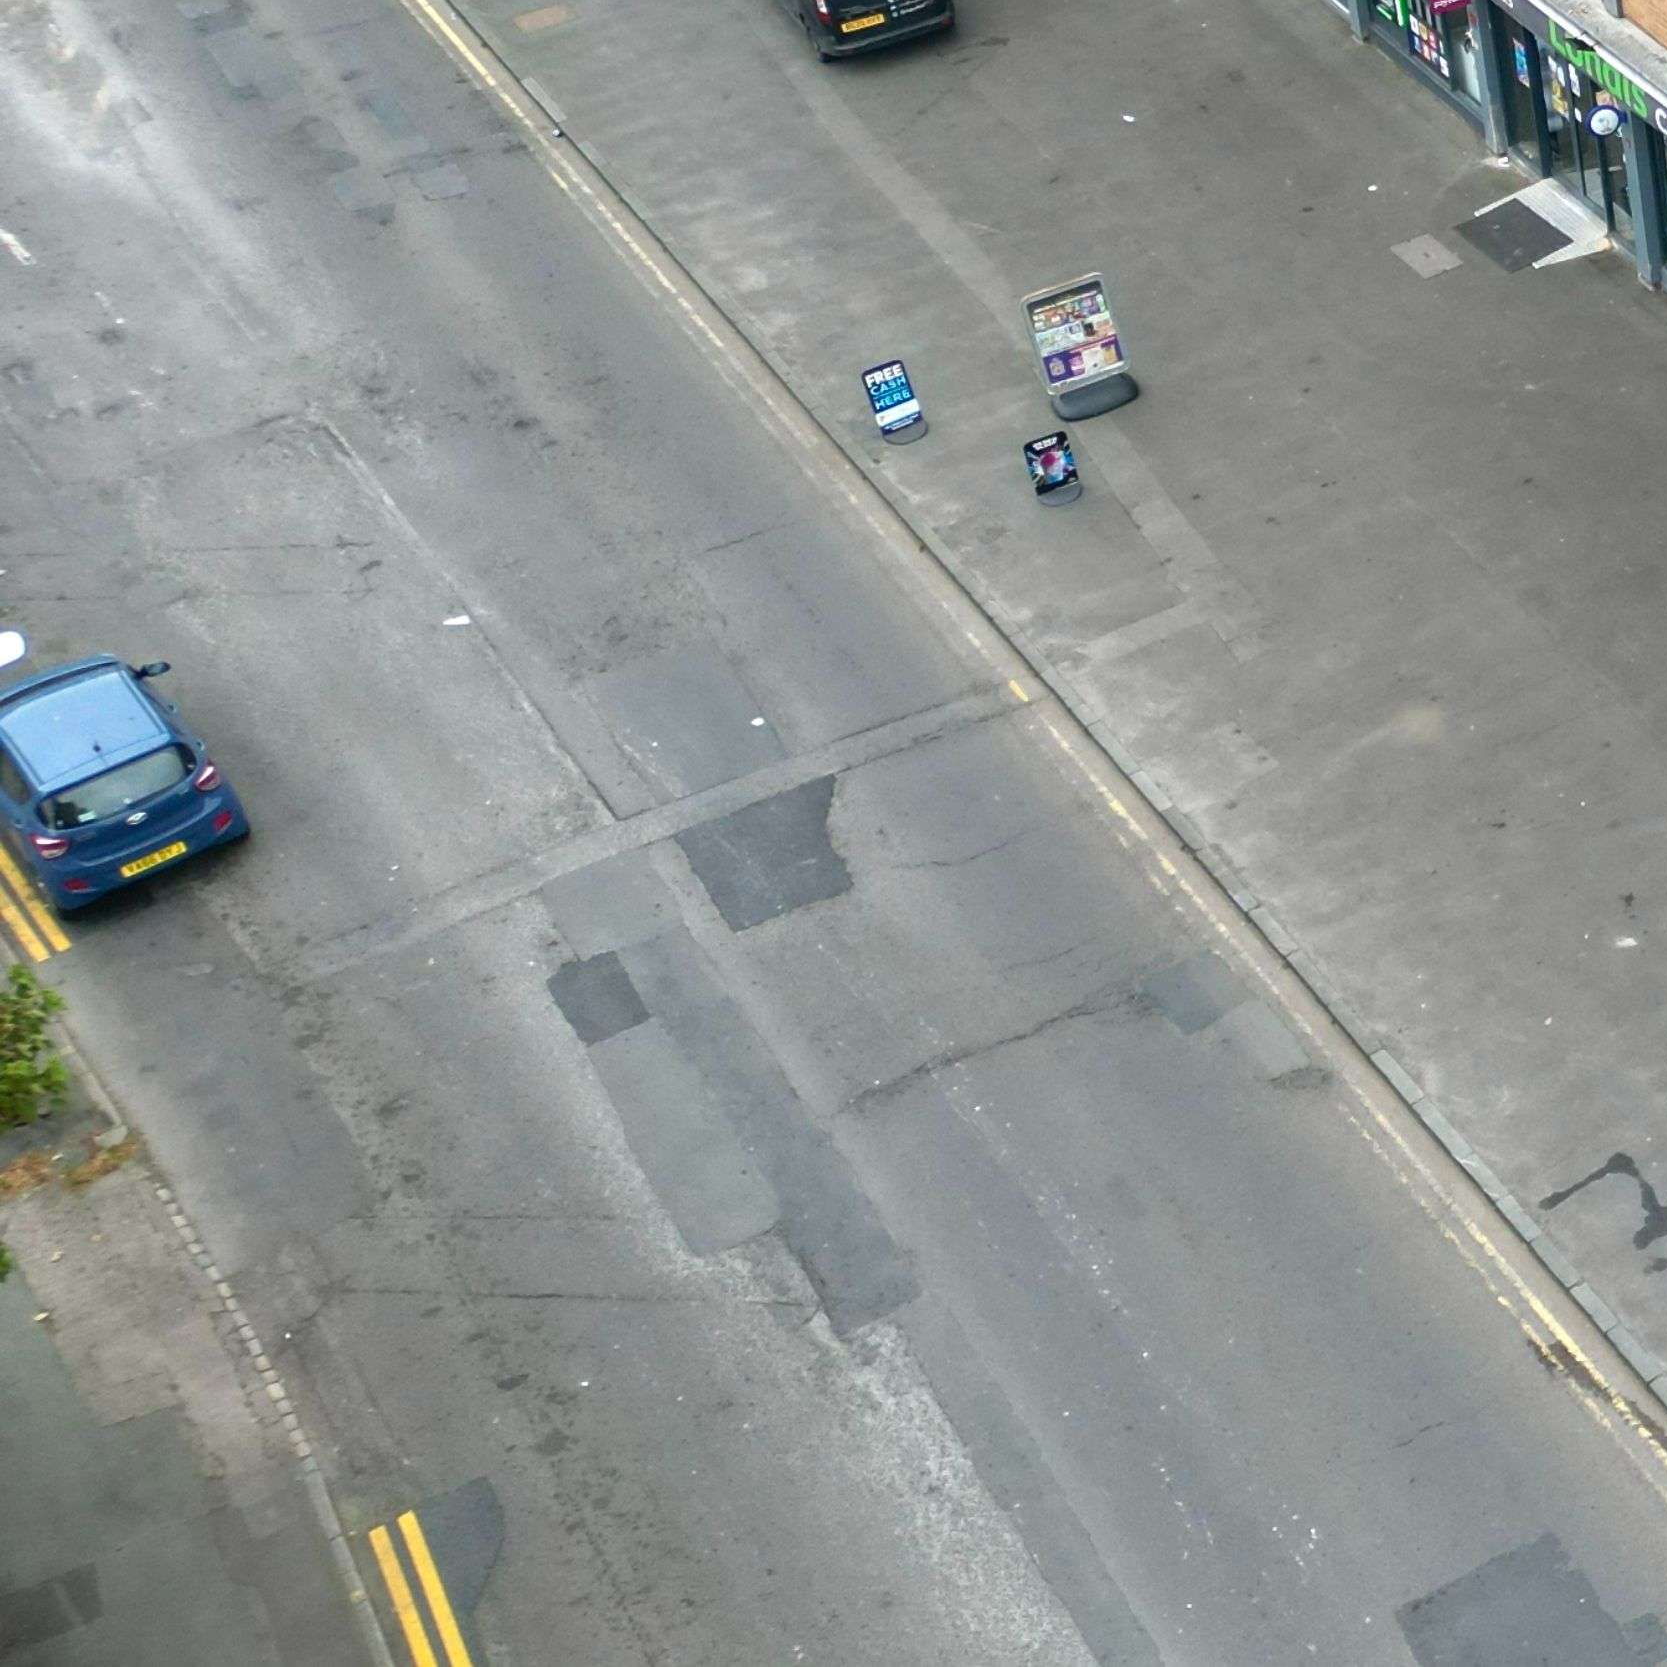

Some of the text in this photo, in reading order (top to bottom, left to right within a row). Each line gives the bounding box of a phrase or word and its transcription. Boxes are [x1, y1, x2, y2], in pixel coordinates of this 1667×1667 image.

[864, 362, 903, 388] FREE
[869, 376, 907, 396] CASH
[874, 388, 911, 411] HERE
